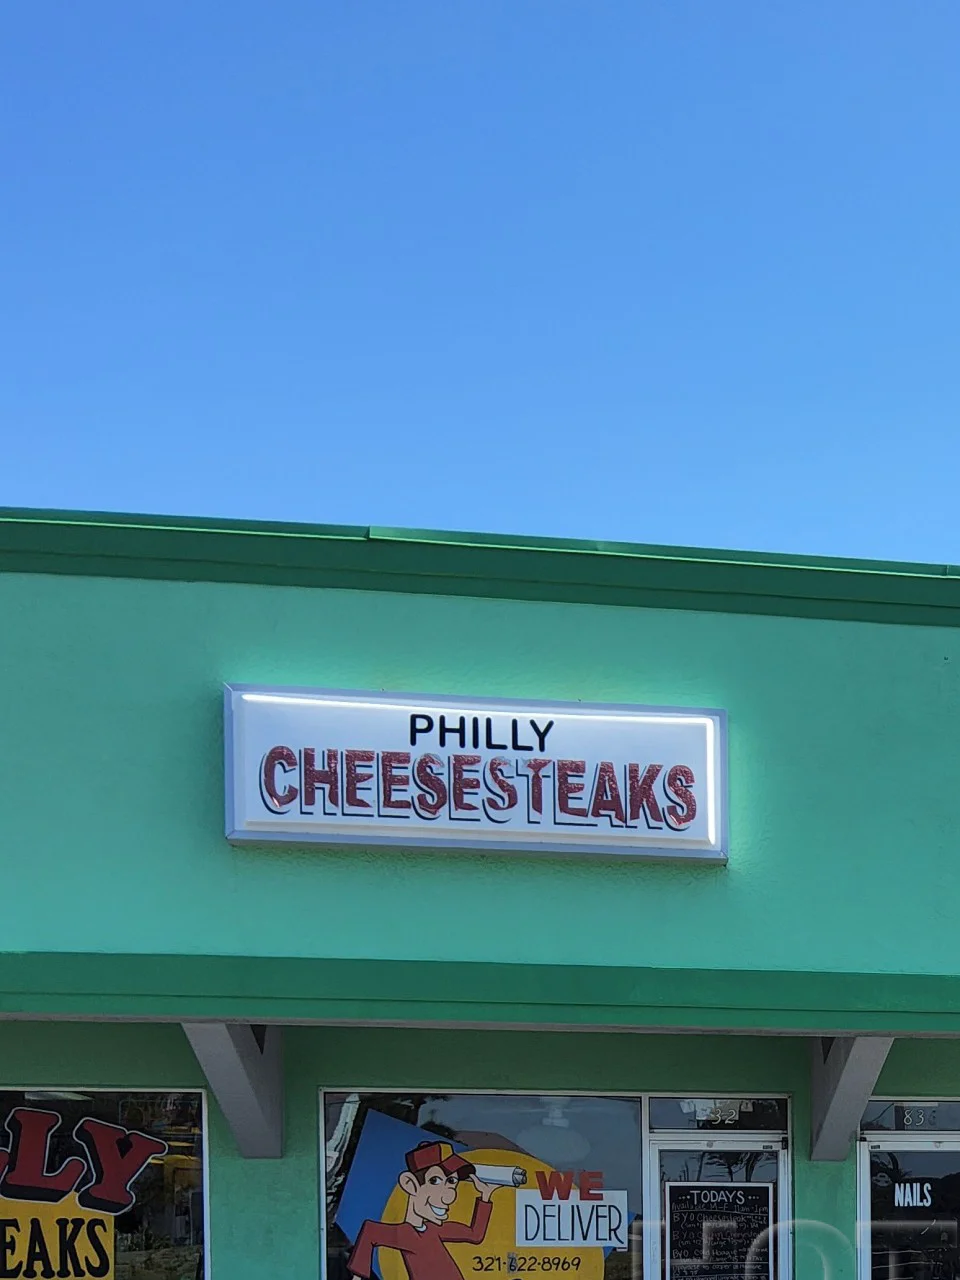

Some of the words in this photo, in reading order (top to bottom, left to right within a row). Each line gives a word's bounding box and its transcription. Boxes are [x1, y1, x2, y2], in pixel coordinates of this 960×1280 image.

[409, 713, 555, 752] PHILLY
[259, 744, 697, 832] CHEESESTEAKS
[536, 1169, 604, 1201] WE
[894, 1182, 932, 1208] NAILS
[524, 1204, 625, 1245] DELIVER
